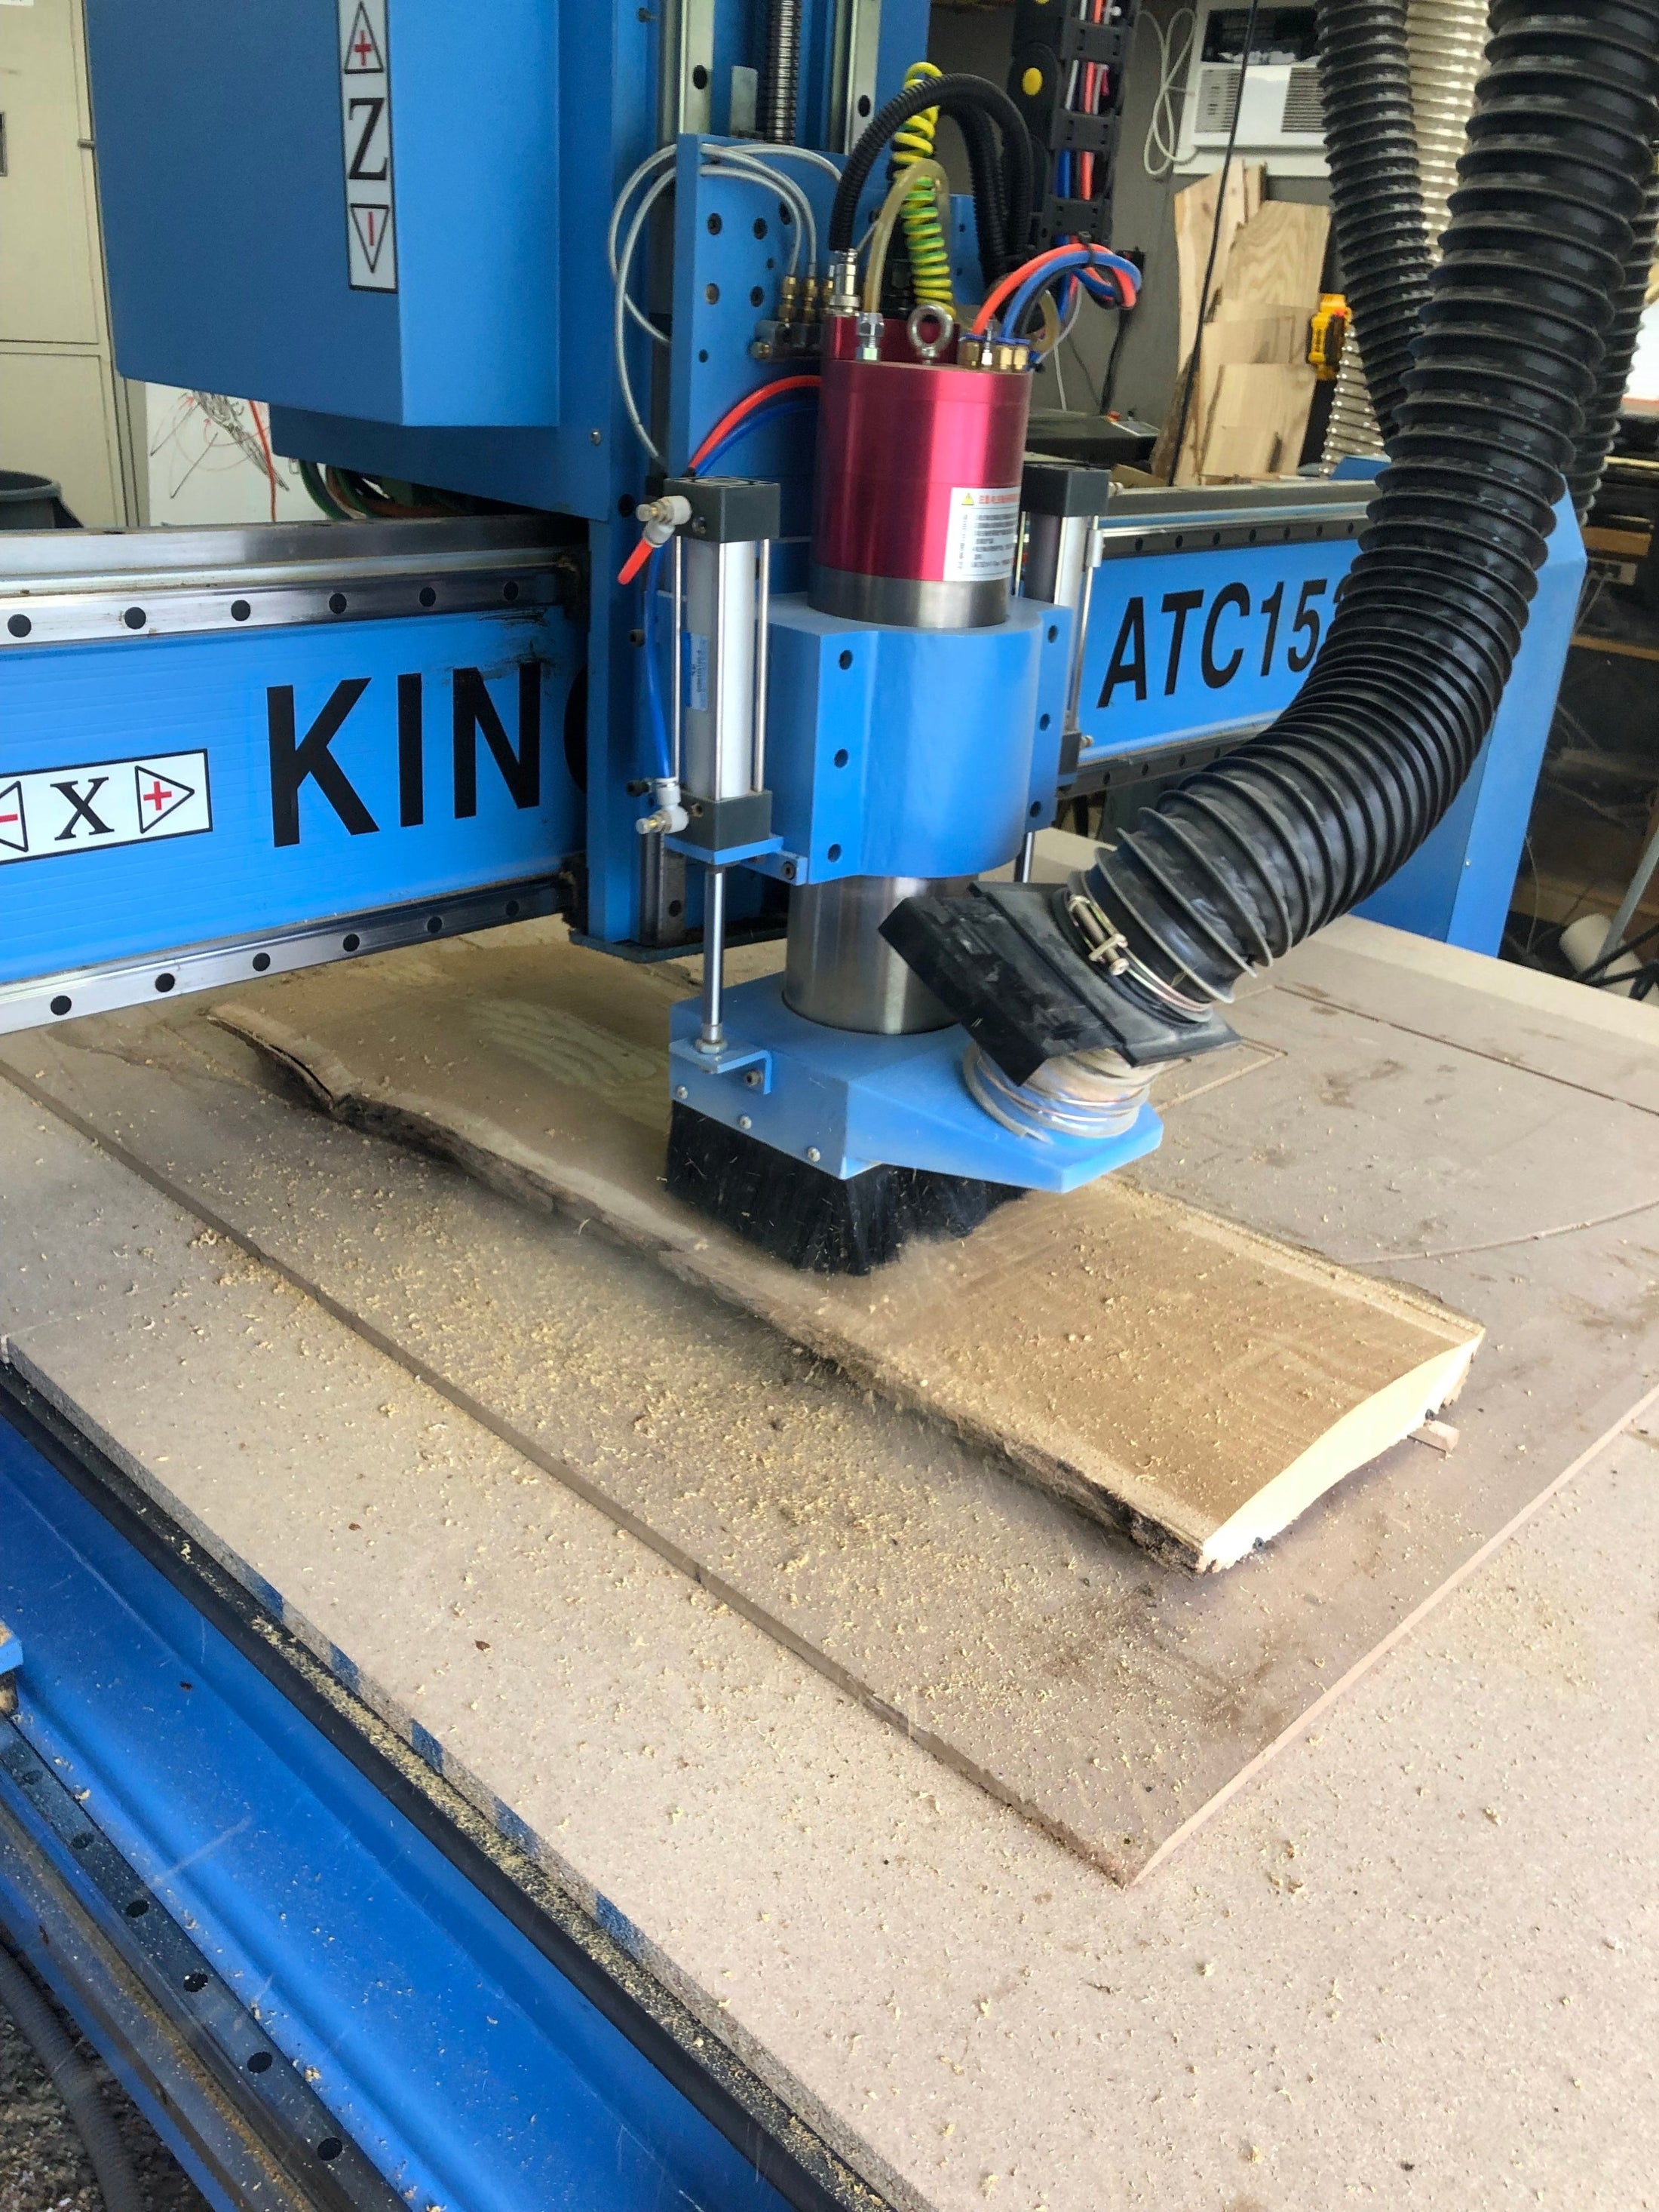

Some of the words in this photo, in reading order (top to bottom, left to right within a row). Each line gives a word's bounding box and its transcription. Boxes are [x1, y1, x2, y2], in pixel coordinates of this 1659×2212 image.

[348, 97, 388, 180] Z
[1096, 578, 1349, 709] ATC15
[50, 777, 115, 841] X
